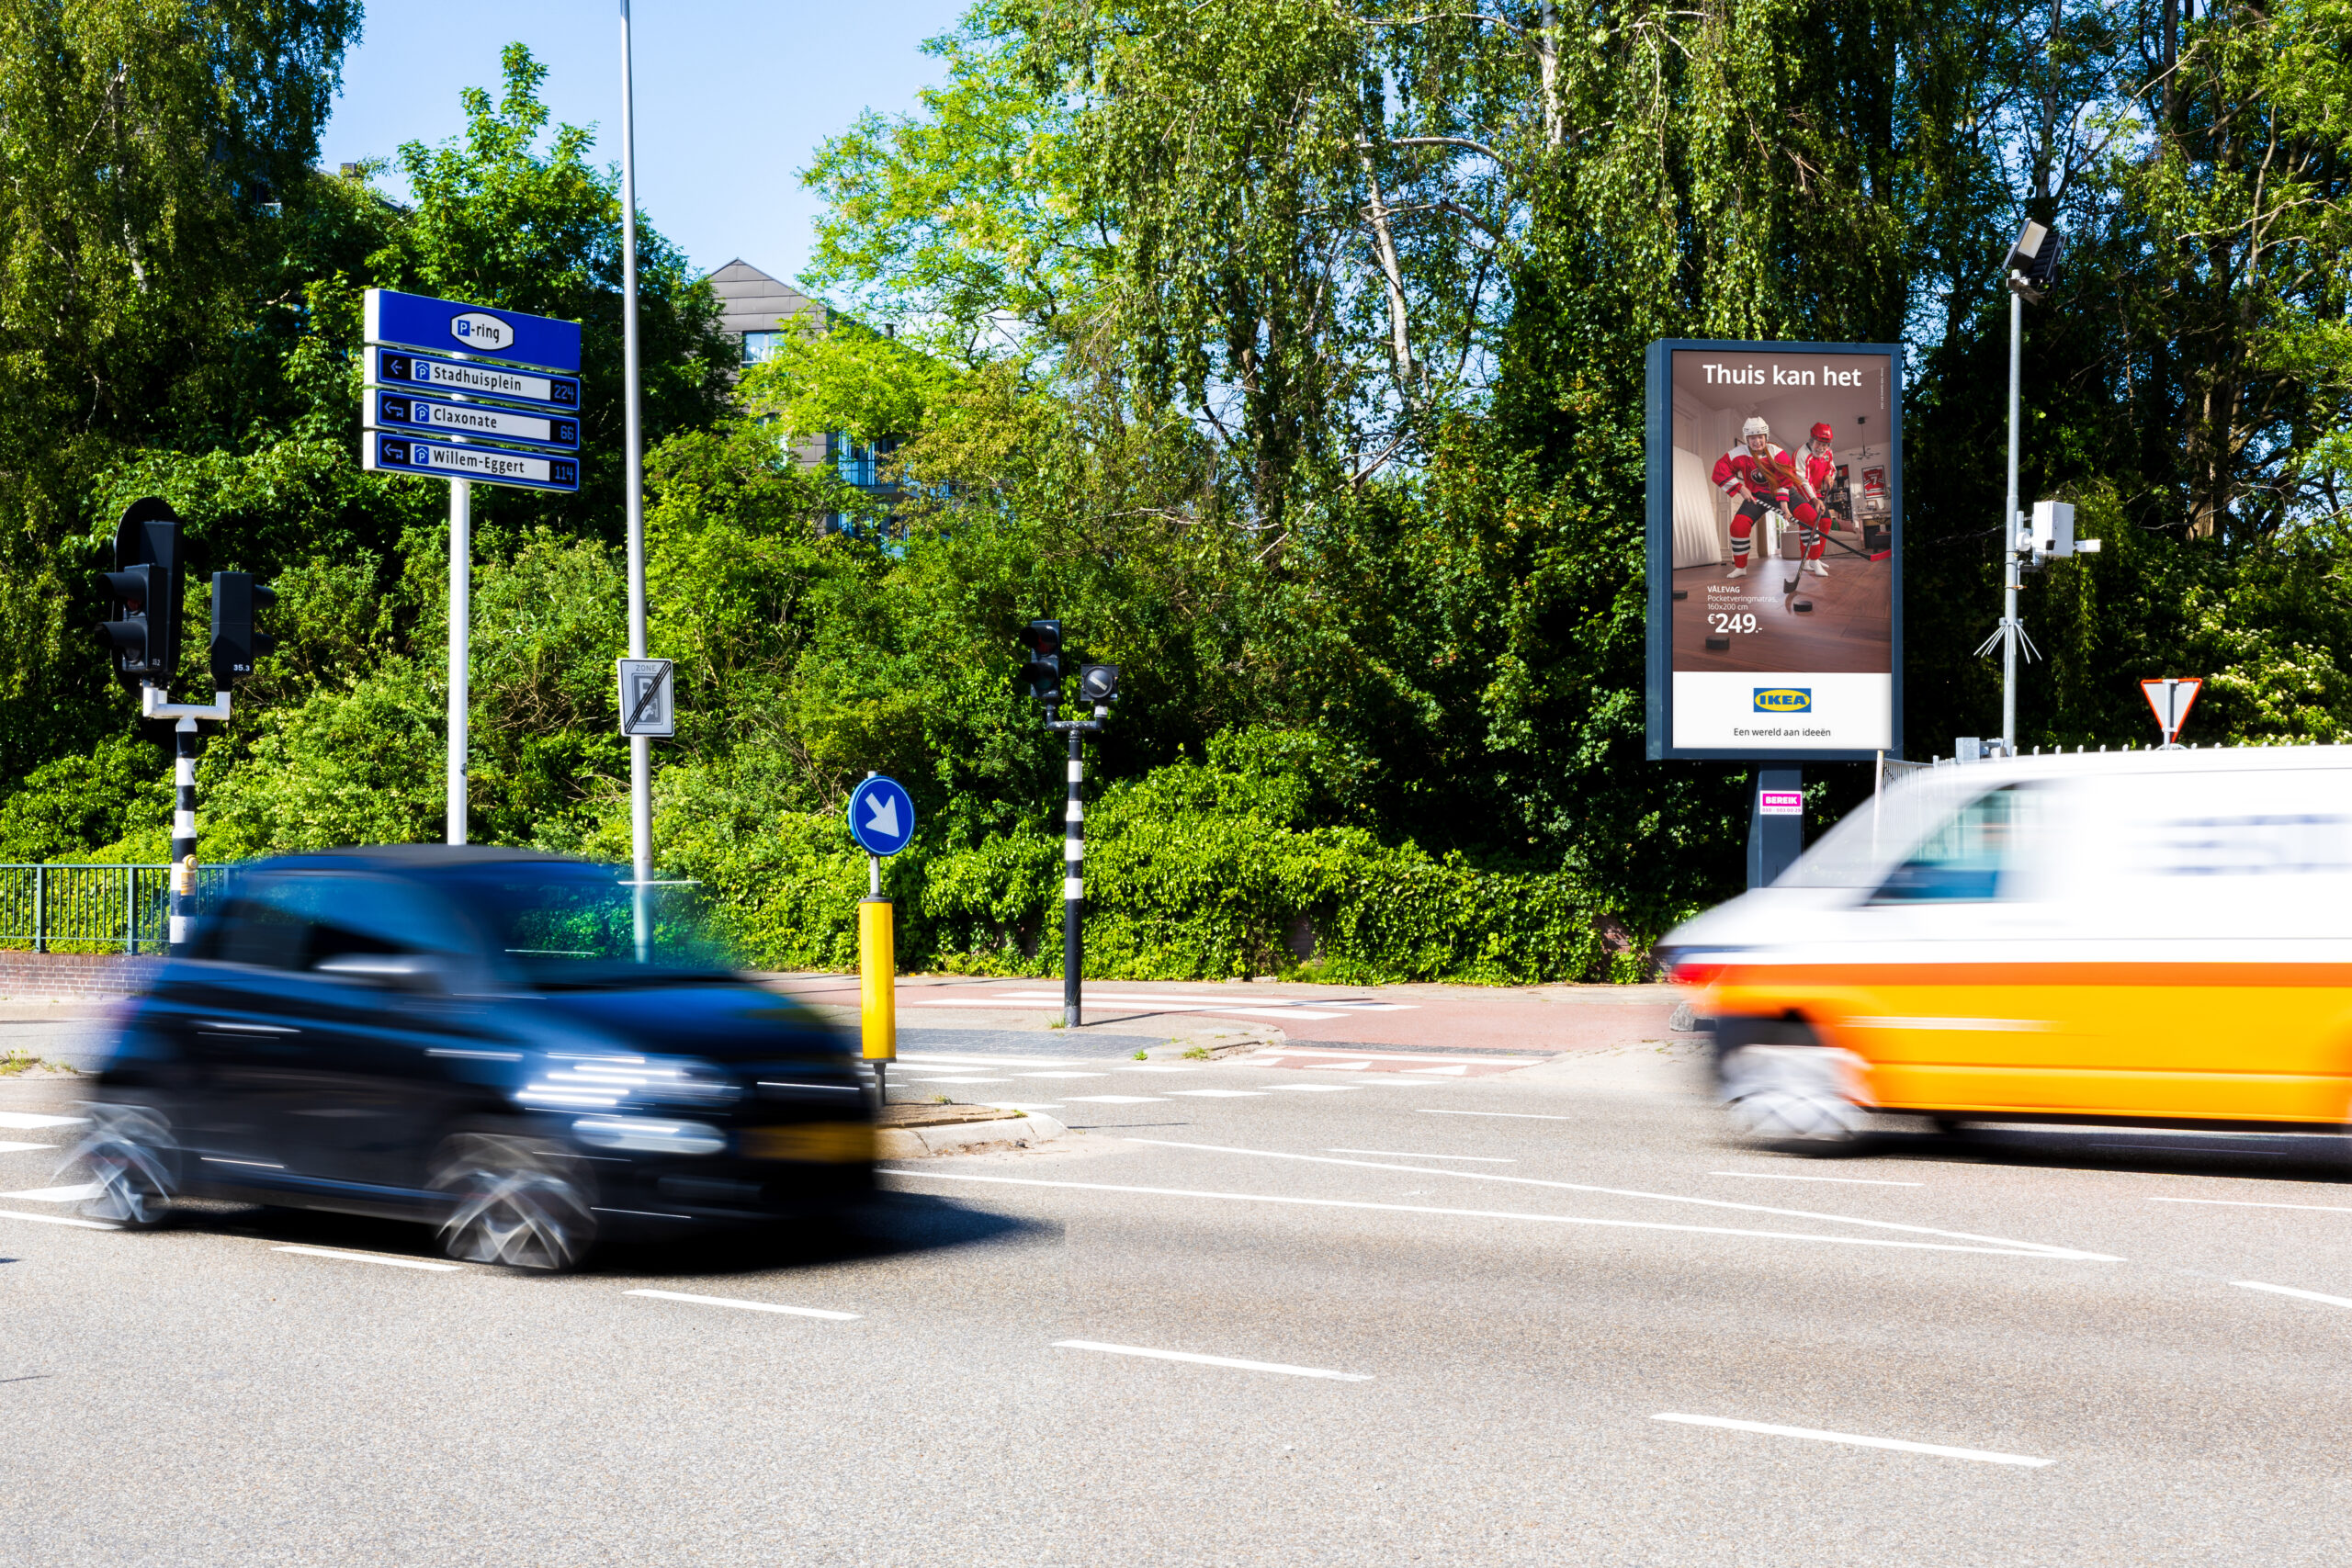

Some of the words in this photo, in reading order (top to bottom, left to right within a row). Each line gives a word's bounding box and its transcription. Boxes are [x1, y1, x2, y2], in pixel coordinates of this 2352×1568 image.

[1702, 364, 1766, 385] Thuis
[1773, 365, 1815, 386] kan
[1824, 366, 1862, 387] het
[434, 367, 522, 391] Stadhuisplein
[554, 384, 574, 400] 224
[434, 408, 498, 429] Claxonate
[560, 425, 574, 440] 66
[434, 449, 525, 474] Willem-Eggert
[554, 465, 573, 481] 114
[1707, 603, 1736, 611] 160x200
[233, 663, 250, 671] 35.3
[1759, 694, 1806, 705] IKEA
[1734, 728, 1750, 737] Een
[1751, 728, 1781, 737] wereld
[1802, 728, 1831, 737] ideeën
[1765, 795, 1798, 805] BEREIK
